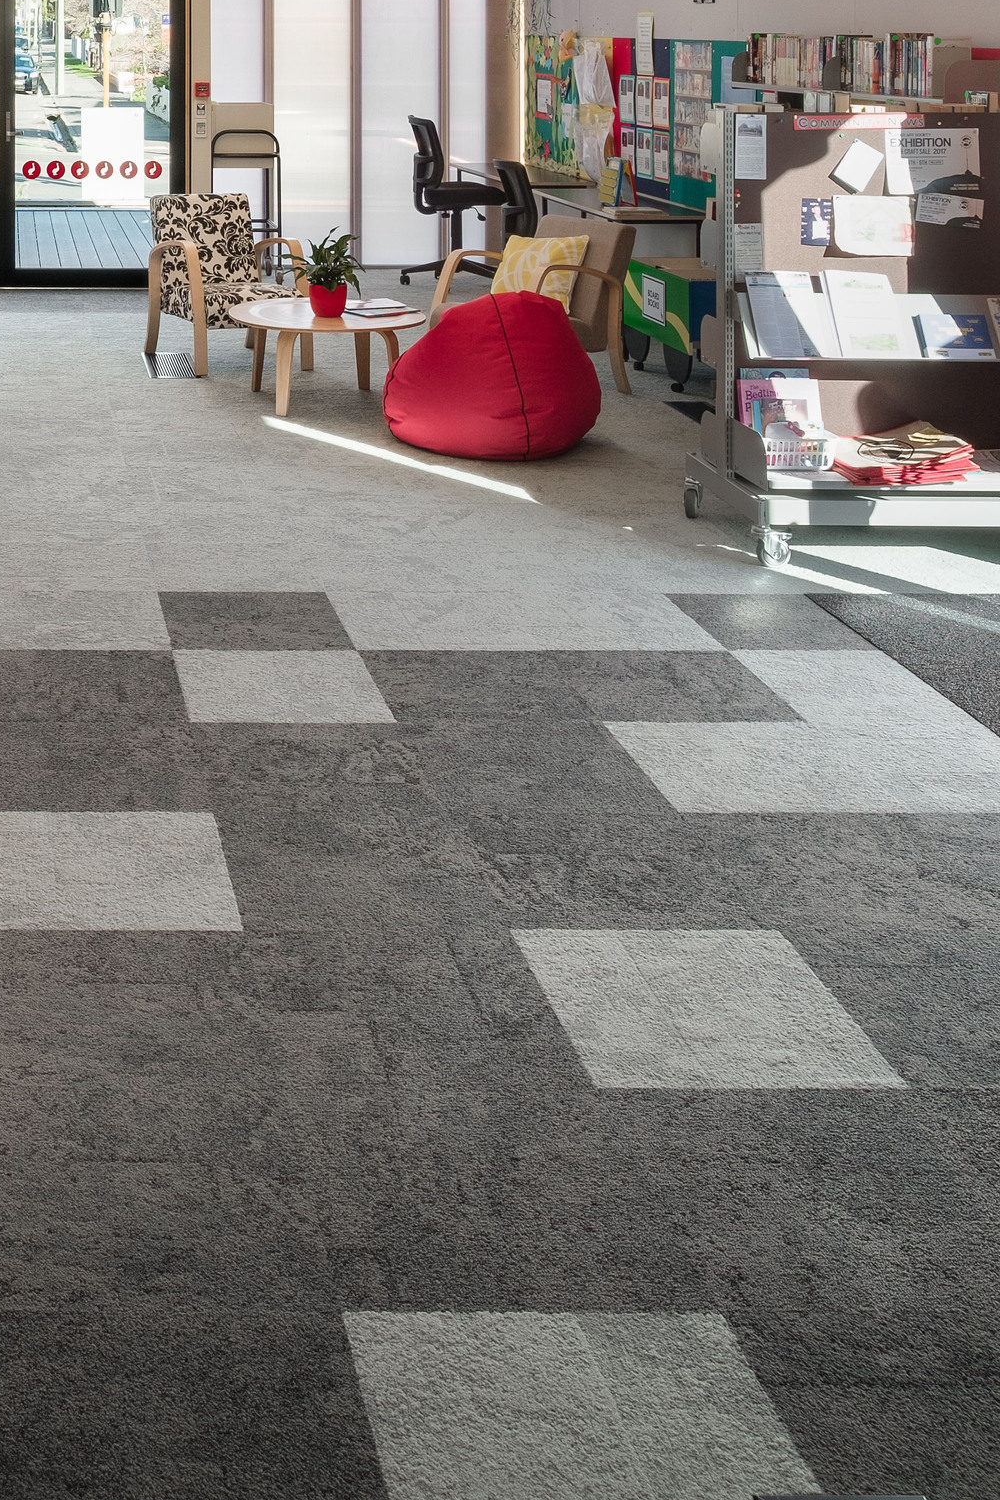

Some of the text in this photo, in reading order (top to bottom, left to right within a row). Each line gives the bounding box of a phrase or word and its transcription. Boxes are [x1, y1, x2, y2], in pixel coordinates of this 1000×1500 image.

[887, 116, 924, 127] NWS
[890, 137, 952, 148] EXHIBITION
[933, 147, 947, 155] 2017
[647, 289, 660, 301] BOARD
[647, 298, 660, 310] BOOKS
[745, 388, 779, 401] Bedtim
